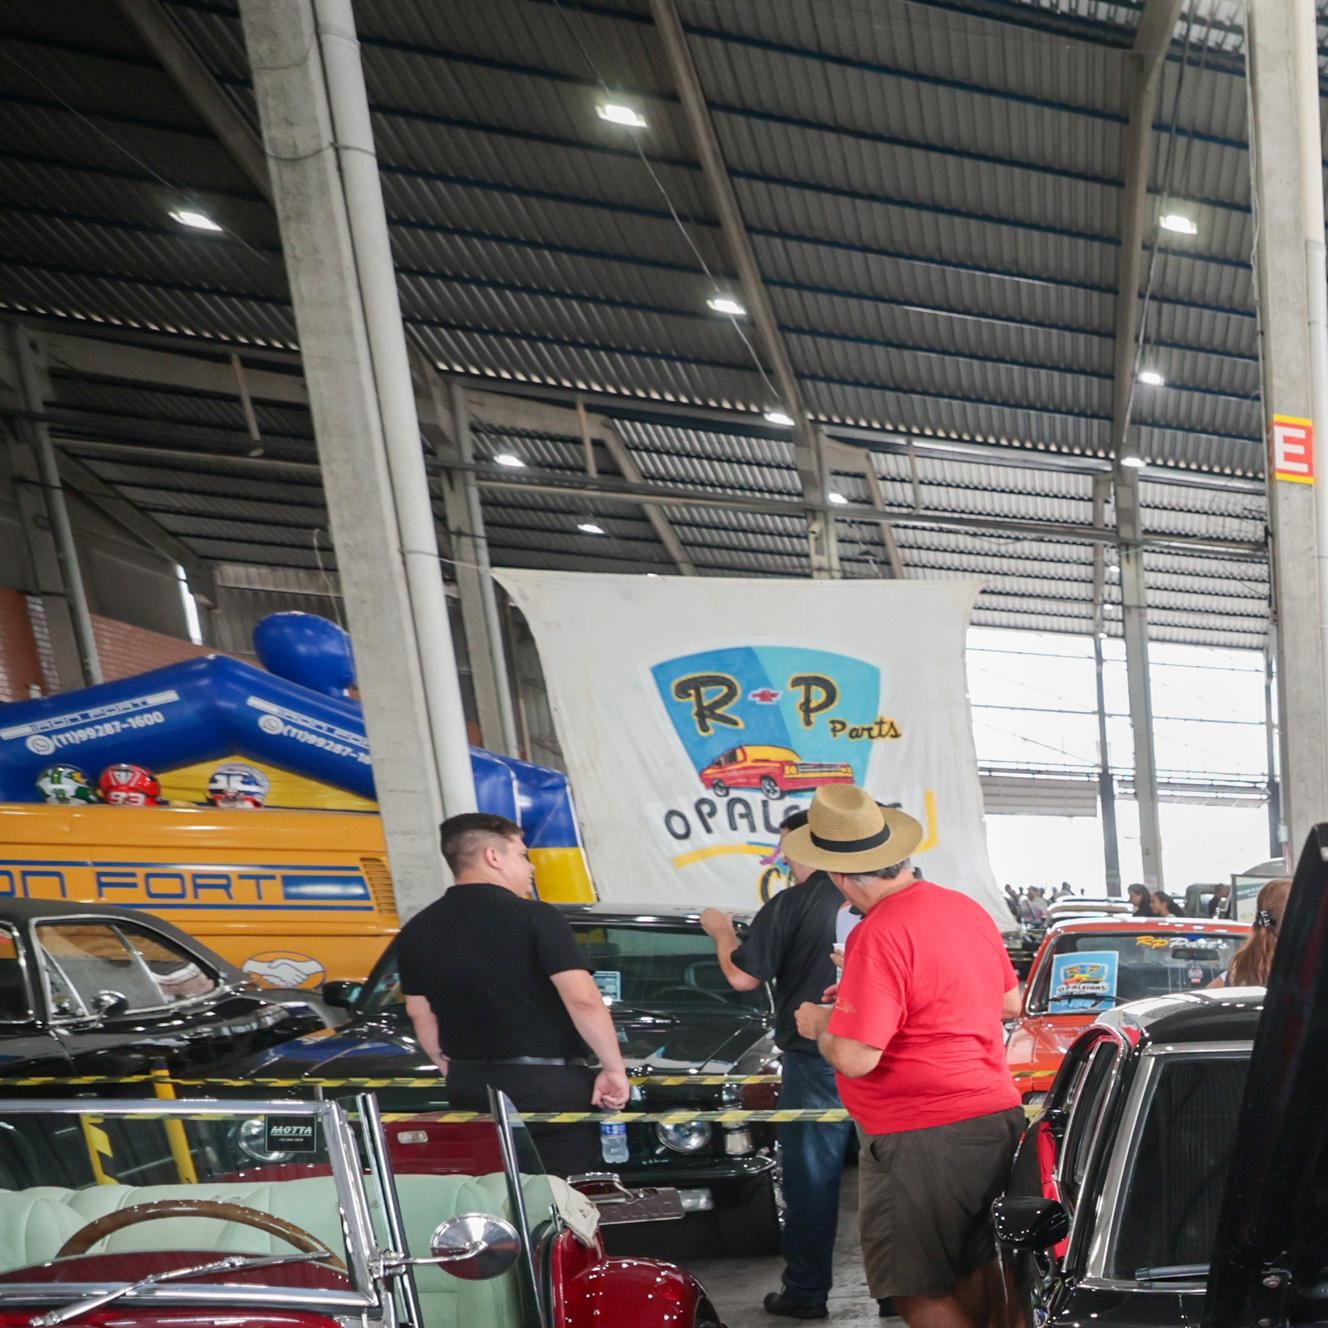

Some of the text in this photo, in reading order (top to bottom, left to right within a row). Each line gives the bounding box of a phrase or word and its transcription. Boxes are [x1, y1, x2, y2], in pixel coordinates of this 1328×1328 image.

[1273, 425, 1310, 473] E
[673, 672, 903, 740] R P Parts
[54, 710, 166, 748] (11)99287-1600
[281, 724, 372, 765] (11)99287-16
[95, 870, 277, 900] FORT
[270, 1125, 313, 1135] MOTTA
